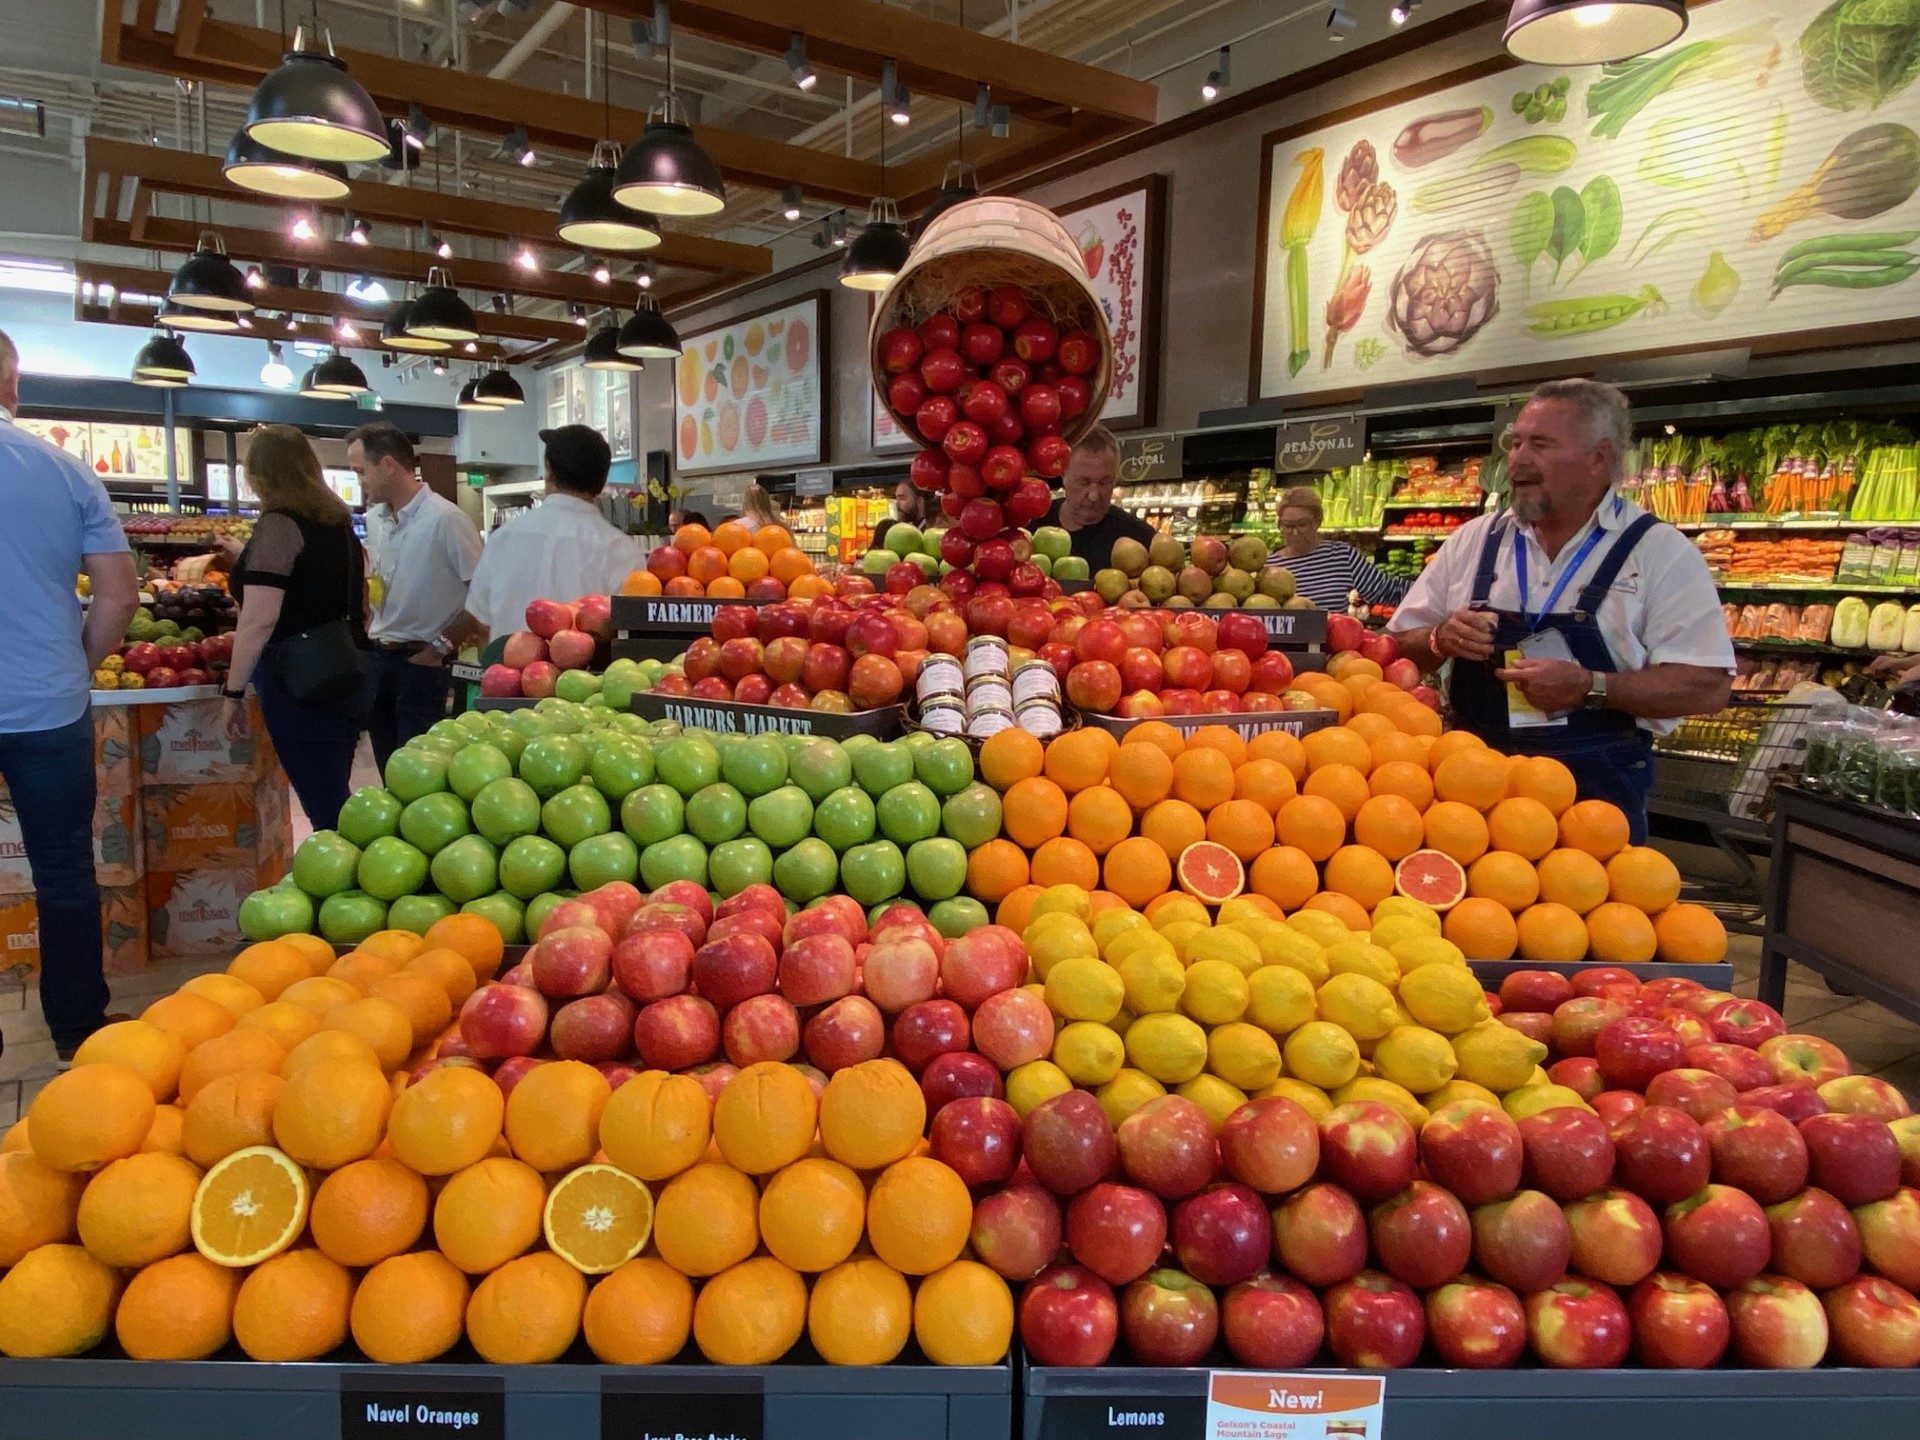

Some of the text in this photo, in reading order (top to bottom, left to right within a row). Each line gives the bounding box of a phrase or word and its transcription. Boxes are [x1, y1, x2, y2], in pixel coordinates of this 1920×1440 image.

[1284, 437, 1354, 453] SEASONAL
[1131, 453, 1165, 466] LOCAL
[665, 704, 811, 735] FARMERS MARKET
[1268, 1389, 1323, 1409] New!
[366, 1403, 480, 1430] Navel Oranges
[1108, 1406, 1165, 1426] Lemons
[1217, 1420, 1296, 1430] Gelson's Coastal
[1216, 1430, 1288, 1440] Mountain Sage
